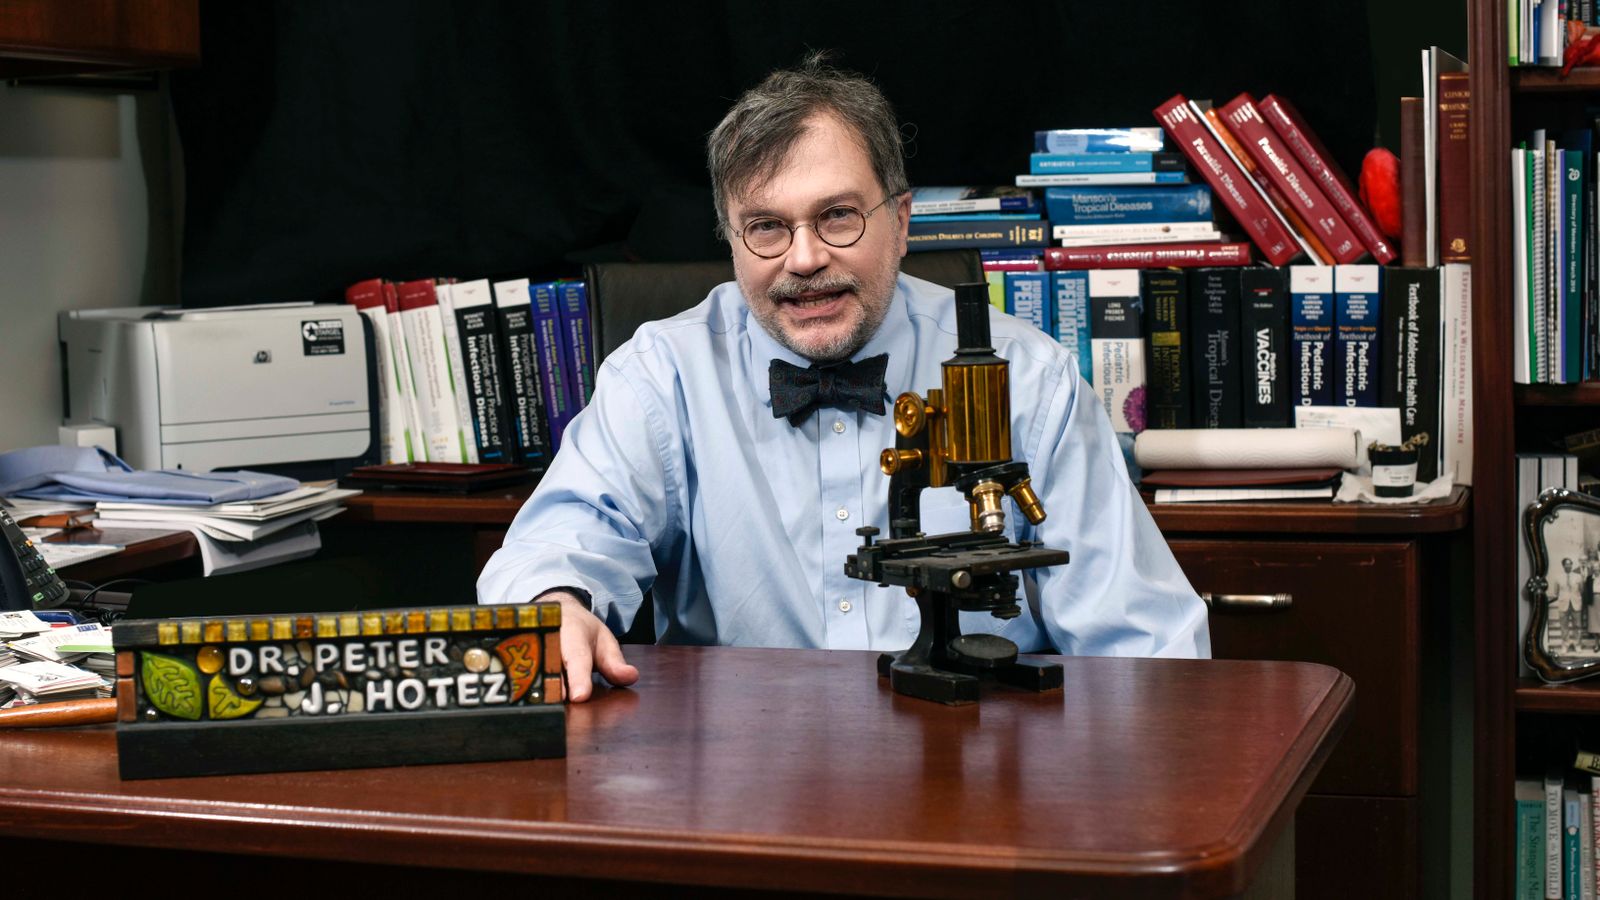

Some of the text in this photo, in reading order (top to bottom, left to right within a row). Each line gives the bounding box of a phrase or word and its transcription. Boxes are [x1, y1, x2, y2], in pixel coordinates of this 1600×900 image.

[1191, 136, 1226, 177] Parasitic
[1218, 172, 1252, 210] Diseases
[1257, 136, 1292, 176] Parasitic
[1284, 172, 1318, 210] Diseases
[1072, 194, 1117, 203] Manson's
[1073, 201, 1153, 213] Tropical Diseases
[1032, 280, 1043, 329] RUDOLPH'S
[1076, 279, 1086, 328] RUDOLPH'S
[1461, 271, 1469, 327] EXPEDITION
[1204, 330, 1223, 384] Tropical
[1221, 331, 1229, 366] Manson's
[1323, 333, 1330, 341] of
[1339, 332, 1376, 341] Textbook of
[1406, 282, 1420, 426] Textbook of Adolescent Health Care
[1103, 342, 1113, 385] Infectious
[1115, 342, 1123, 384] Pediatric
[1172, 346, 1182, 392] TROPICAL
[1256, 328, 1271, 404] VACCINES
[1301, 341, 1312, 398] Infectious
[1313, 341, 1324, 391] Pediatric
[1346, 341, 1356, 398] Infectious
[1358, 341, 1369, 392] Pediatric
[1458, 336, 1467, 395] WILDERNESS
[467, 336, 490, 448] Infectious Diseases
[479, 334, 501, 446] Principles and Practice of
[509, 335, 531, 447] Infectious Diseases
[520, 334, 542, 445] Principles and Practice of
[1457, 399, 1465, 445] MEDICINE
[227, 638, 450, 676] DR. PETER
[302, 673, 508, 714] J. HOTEZ
[1530, 816, 1540, 832] The
[1549, 790, 1558, 895] TO MOVE WORLD
[1528, 835, 1540, 879] Strangest
